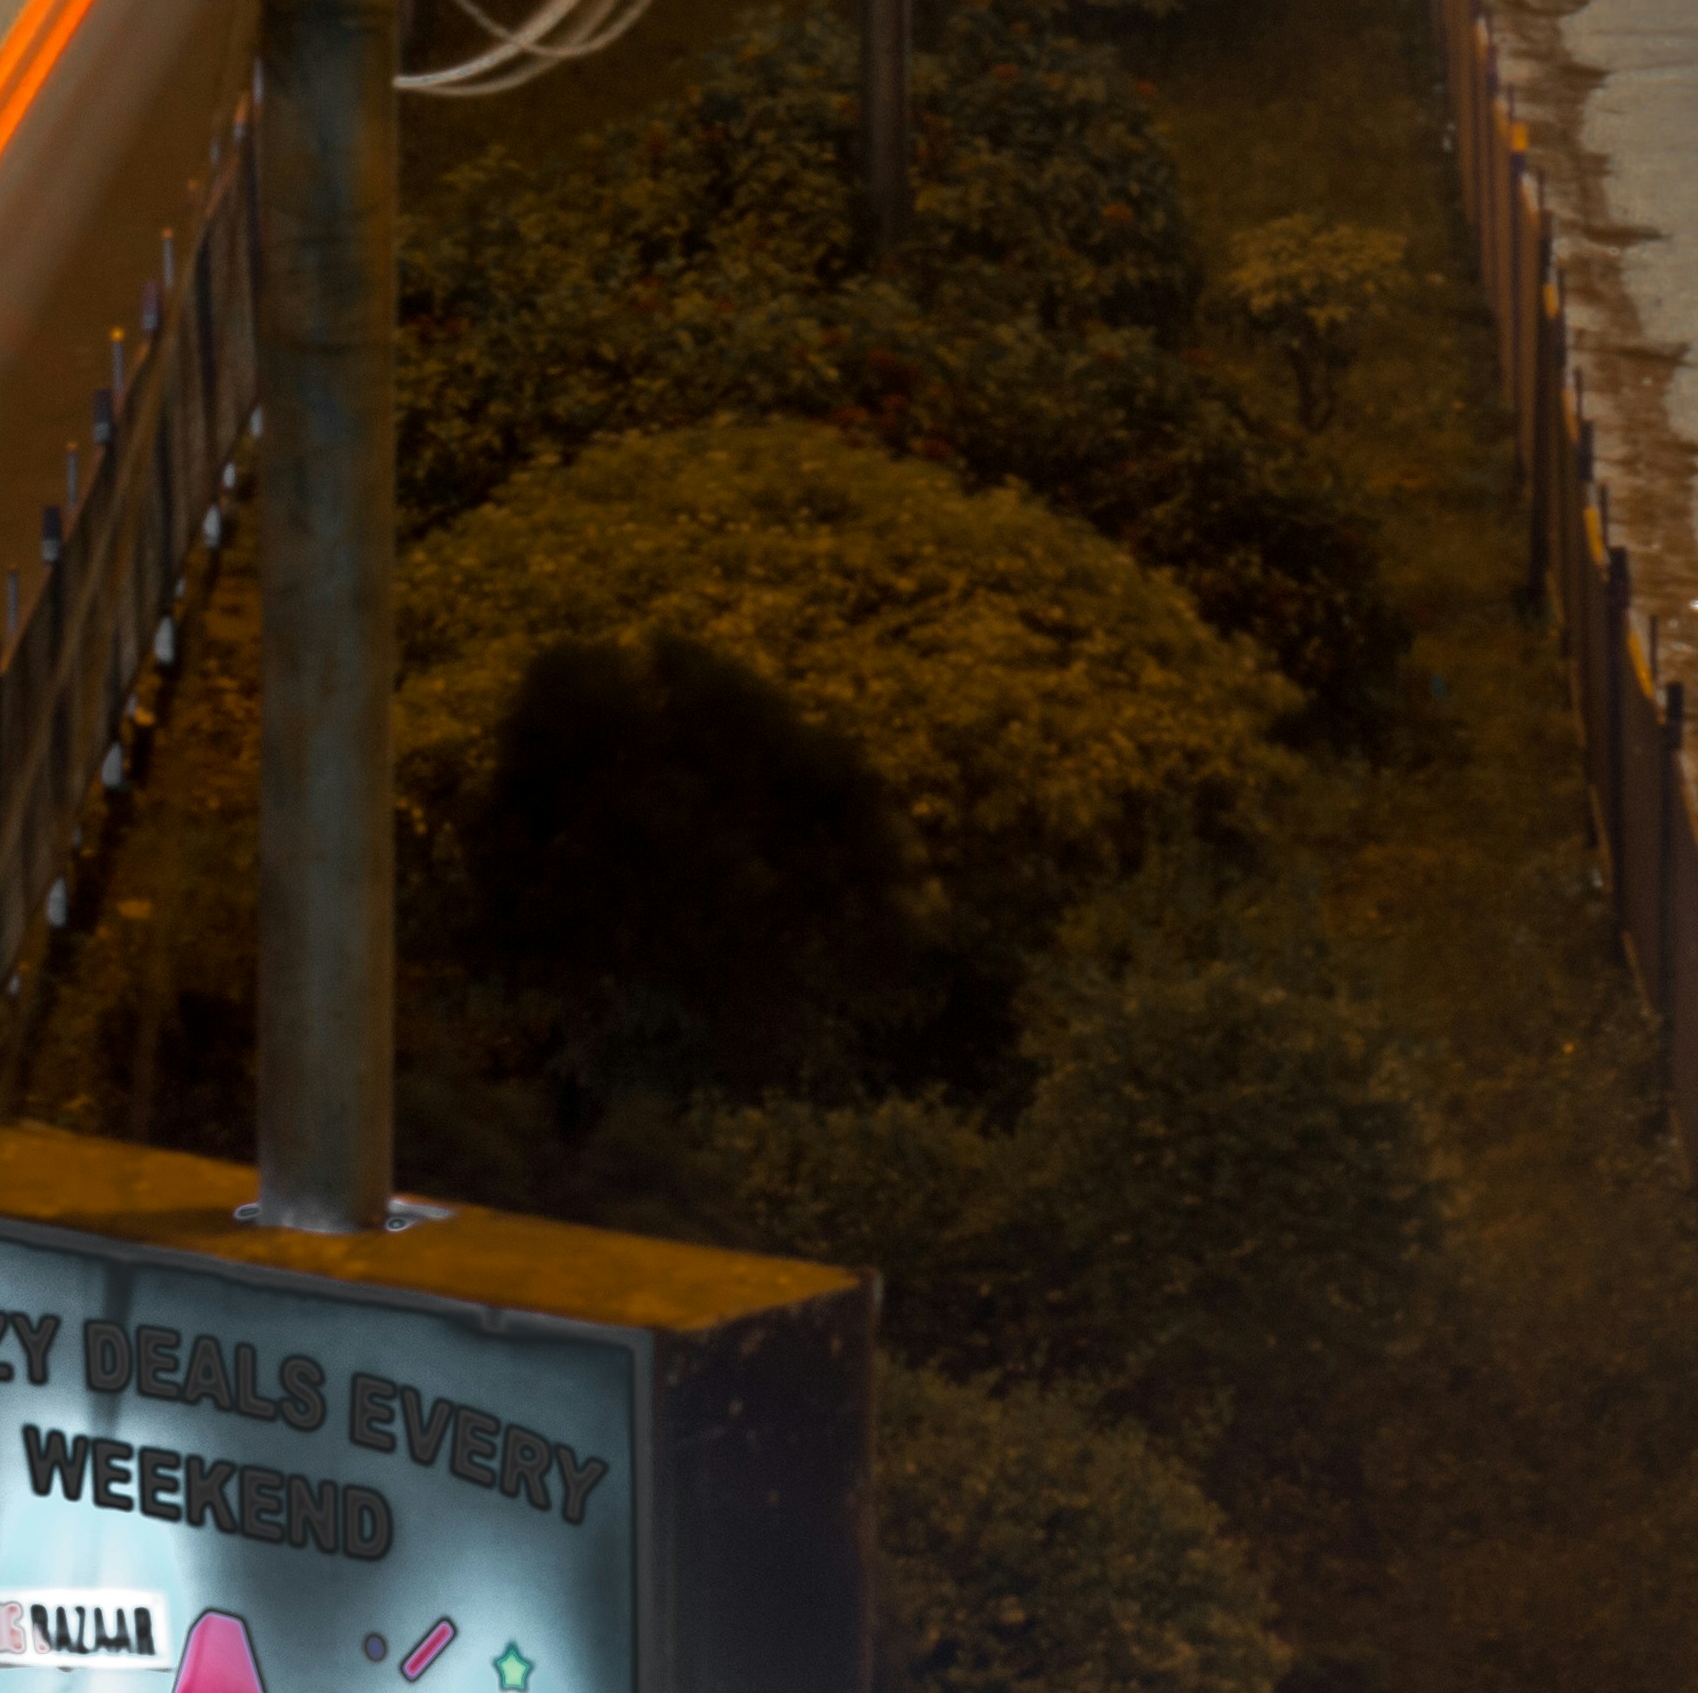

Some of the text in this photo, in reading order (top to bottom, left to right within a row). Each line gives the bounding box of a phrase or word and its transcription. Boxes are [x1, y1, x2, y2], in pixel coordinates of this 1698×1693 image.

[84, 1317, 326, 1432] DEALS
[350, 1371, 609, 1526] EVERY
[22, 1424, 393, 1561] WEEKEND
[31, 1603, 156, 1656] BAZAAR
